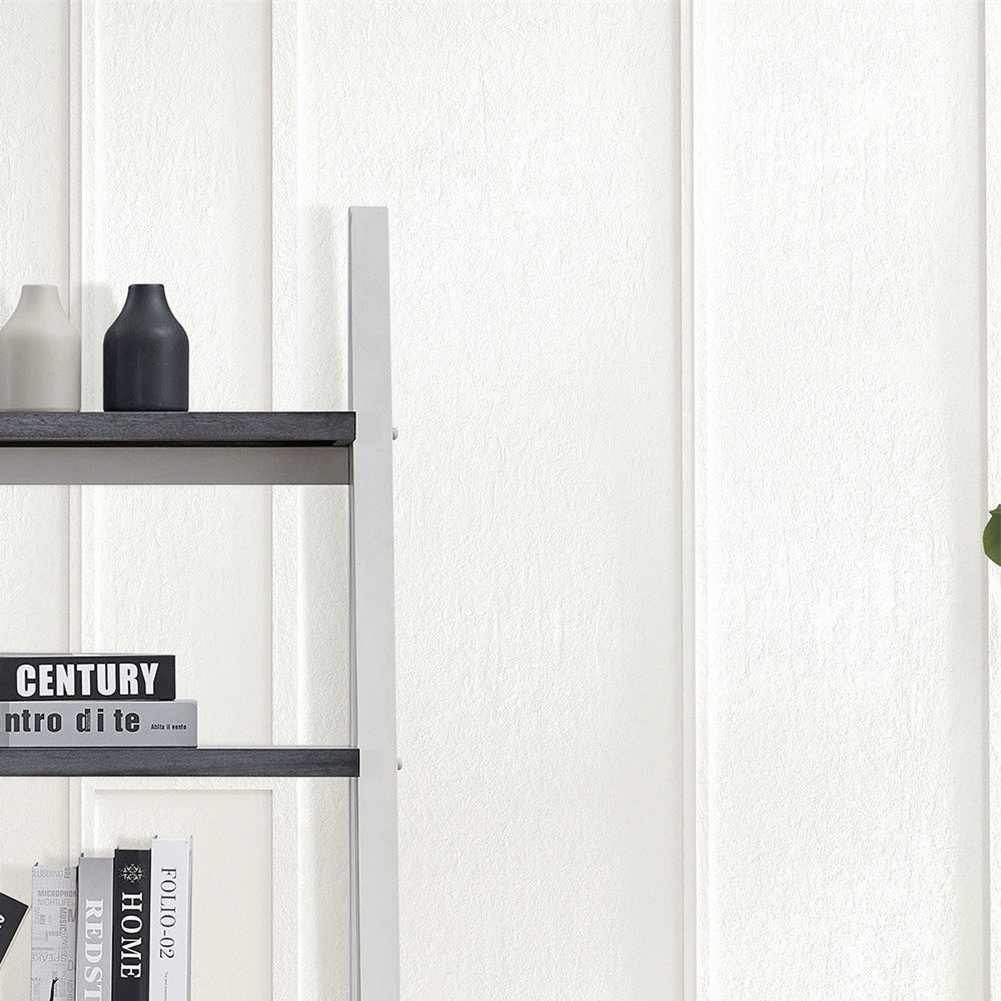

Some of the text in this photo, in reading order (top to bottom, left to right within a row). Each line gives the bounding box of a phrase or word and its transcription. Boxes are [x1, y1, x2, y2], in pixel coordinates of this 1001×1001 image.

[16, 662, 159, 698] CENTURY
[76, 708, 104, 733] di
[113, 709, 140, 733] te
[120, 892, 143, 978] HOME
[159, 868, 177, 959] FOLIO-02
